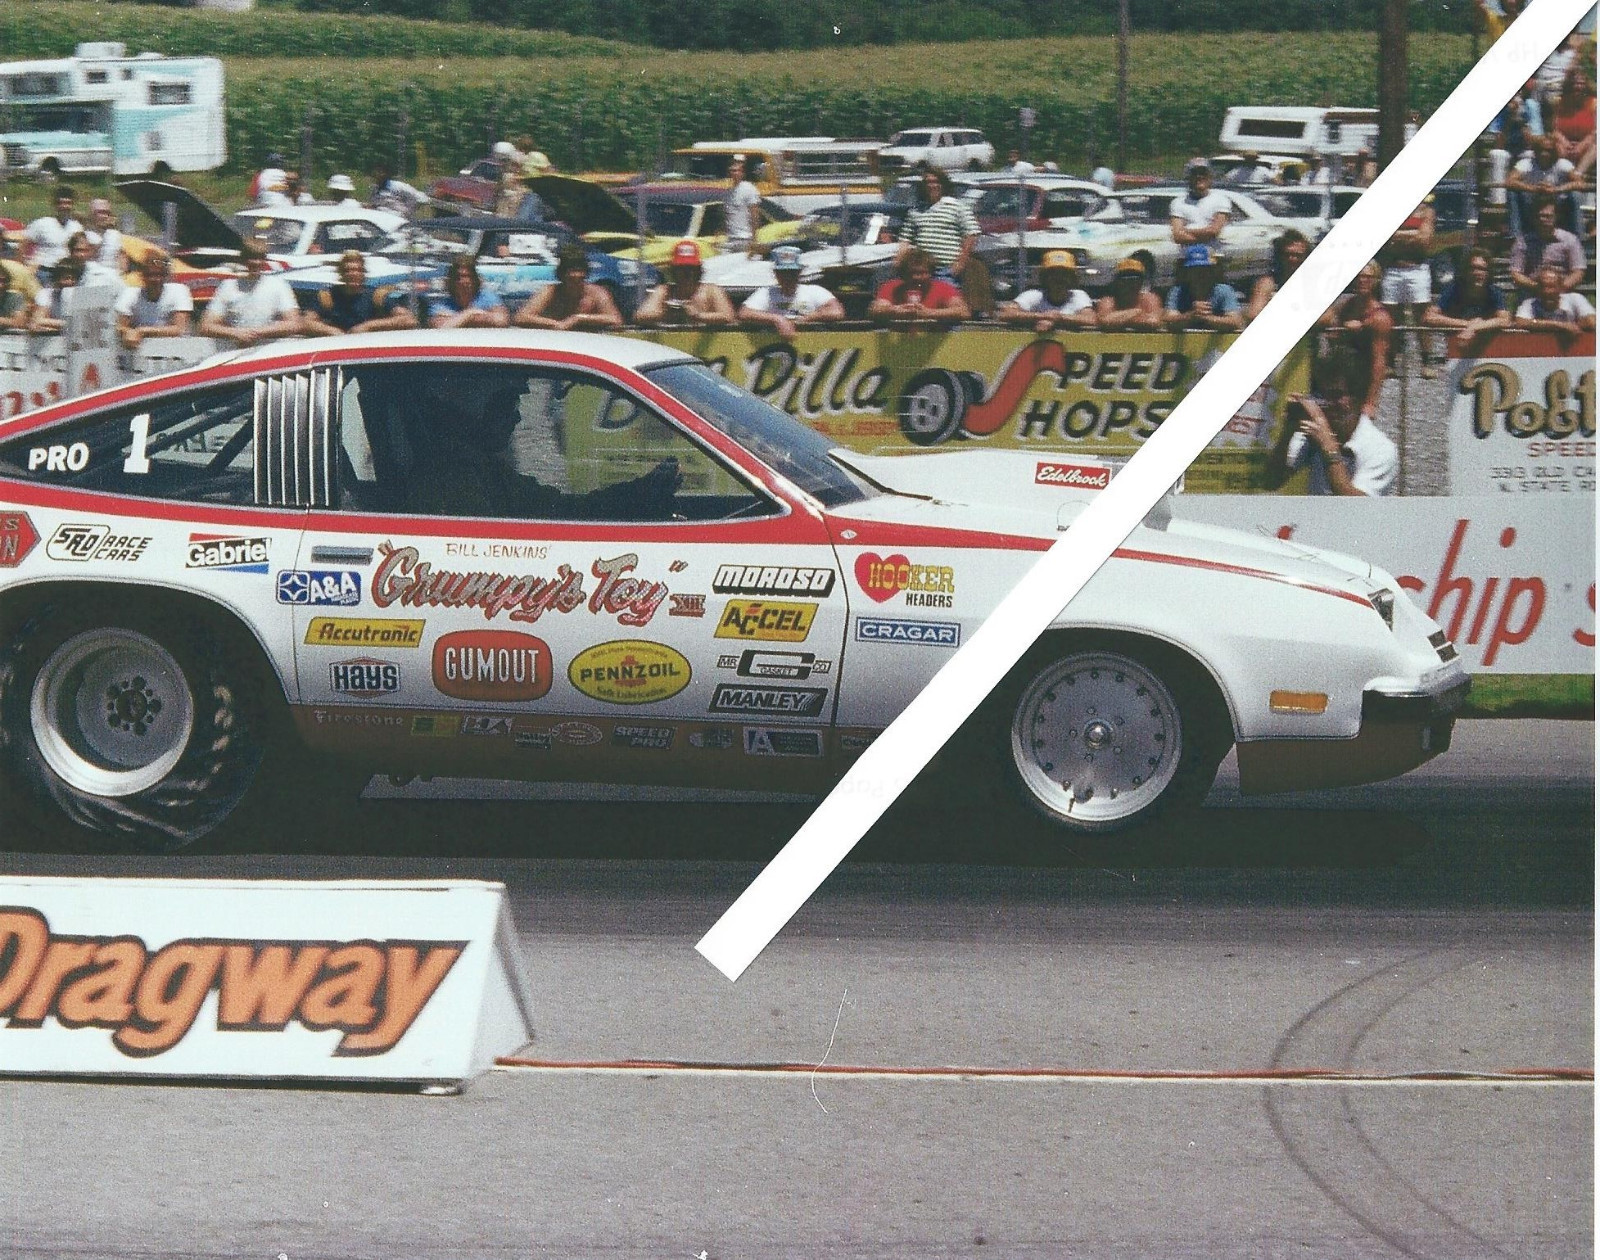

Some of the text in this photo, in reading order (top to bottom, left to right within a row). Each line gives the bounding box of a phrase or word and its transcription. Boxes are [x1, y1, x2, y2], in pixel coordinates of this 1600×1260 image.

[123, 413, 150, 474] 1
[28, 442, 90, 472] PRO
[1037, 466, 1108, 487] Edelbrock
[103, 536, 153, 550] RACE
[189, 540, 270, 566] Gabriel
[446, 542, 479, 558] BILL
[95, 549, 145, 561] CARS
[310, 572, 358, 603] A&A
[712, 564, 836, 598] MOROSO
[867, 562, 955, 593] HOOKER
[905, 593, 953, 608] HEADERS
[723, 603, 807, 636] ACCEL
[319, 621, 419, 643] Accutronic
[862, 625, 953, 641] CRAGAR
[444, 646, 540, 684] GUMOUT
[579, 663, 681, 683] PENNZOIL
[717, 689, 806, 711] MANLEY
[315, 710, 404, 726] Firestone
[0, 905, 471, 1058] Dragway
